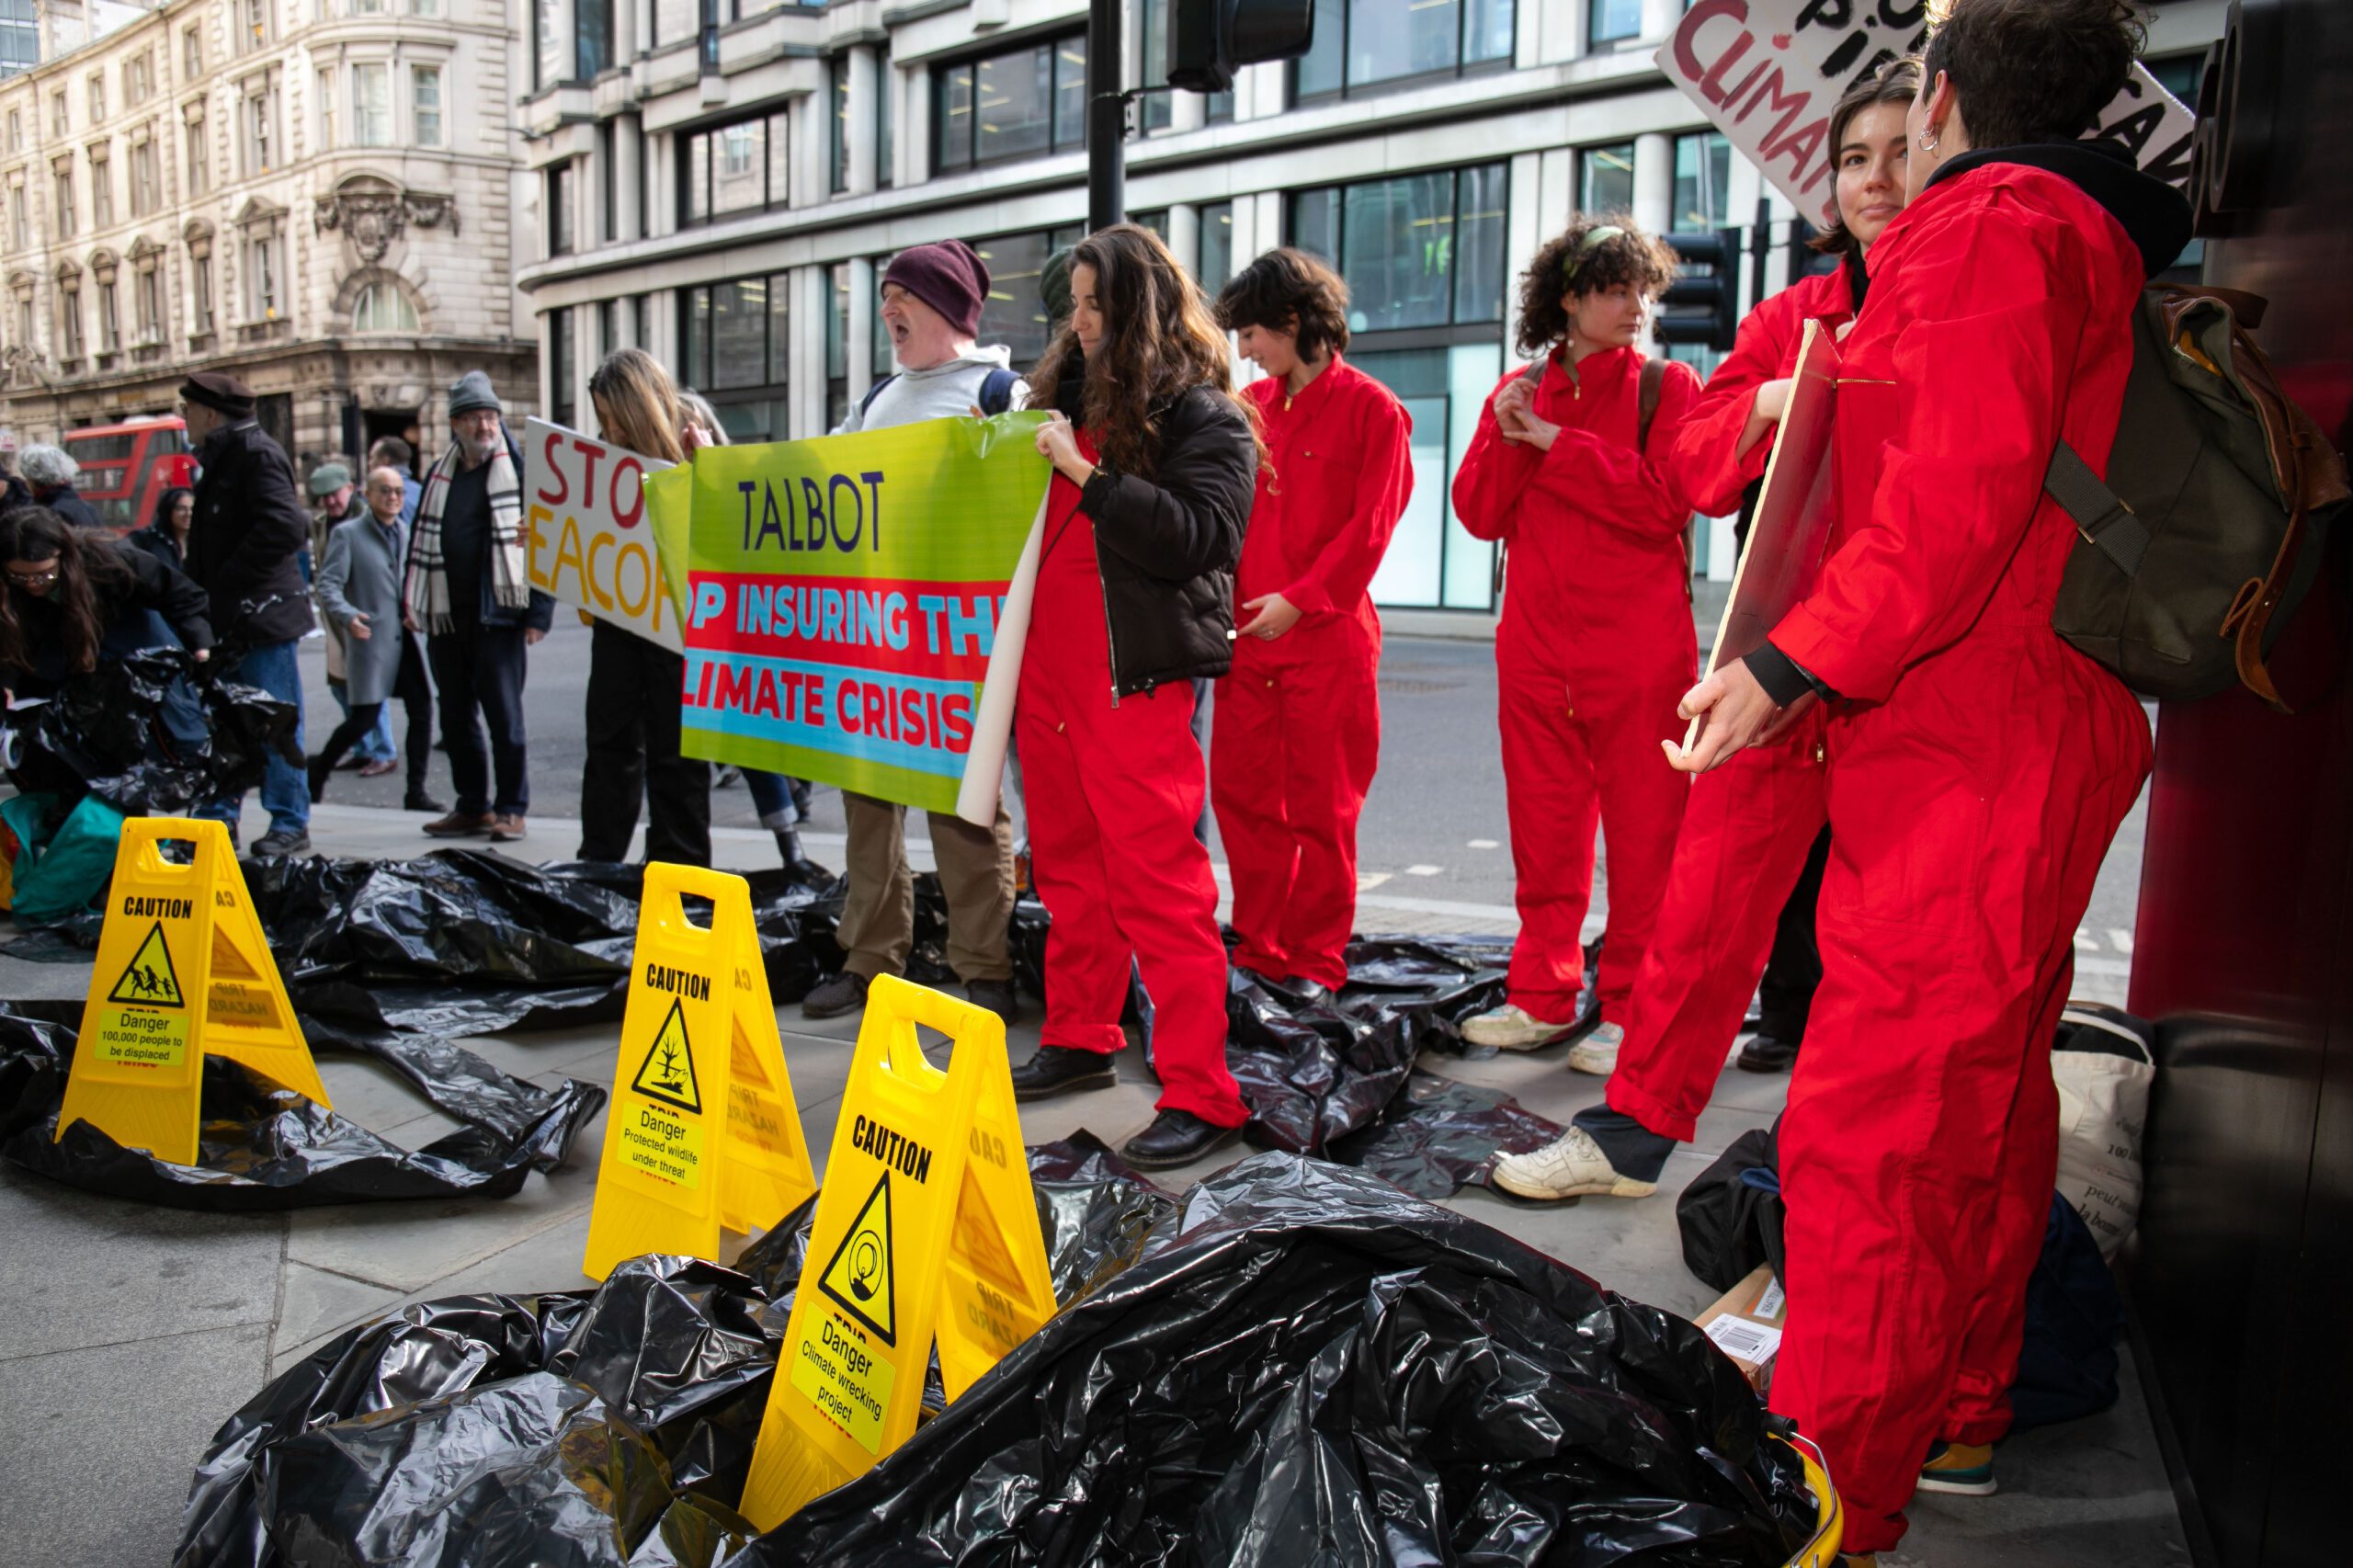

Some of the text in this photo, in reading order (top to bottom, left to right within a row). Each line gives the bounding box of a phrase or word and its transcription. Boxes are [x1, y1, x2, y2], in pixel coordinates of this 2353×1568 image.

[738, 471, 885, 553] TALBOT
[686, 581, 727, 630] P
[736, 584, 909, 652] INSURING
[837, 679, 974, 755] CRISIS
[123, 896, 193, 919] CAUTION
[646, 962, 711, 1002] CAUTION
[102, 1031, 183, 1048] 100,000 people to
[119, 1013, 170, 1032] Danger
[110, 1046, 170, 1061] be displaced
[641, 1109, 686, 1141] Danger
[624, 1128, 698, 1165] Protected wildlife
[632, 1152, 657, 1168] under
[659, 1160, 686, 1179] threat
[852, 1114, 932, 1185] CAUTION
[822, 1319, 873, 1377] Danger
[802, 1340, 836, 1379] Climate
[838, 1371, 882, 1422] wrecking
[817, 1385, 853, 1424] project
